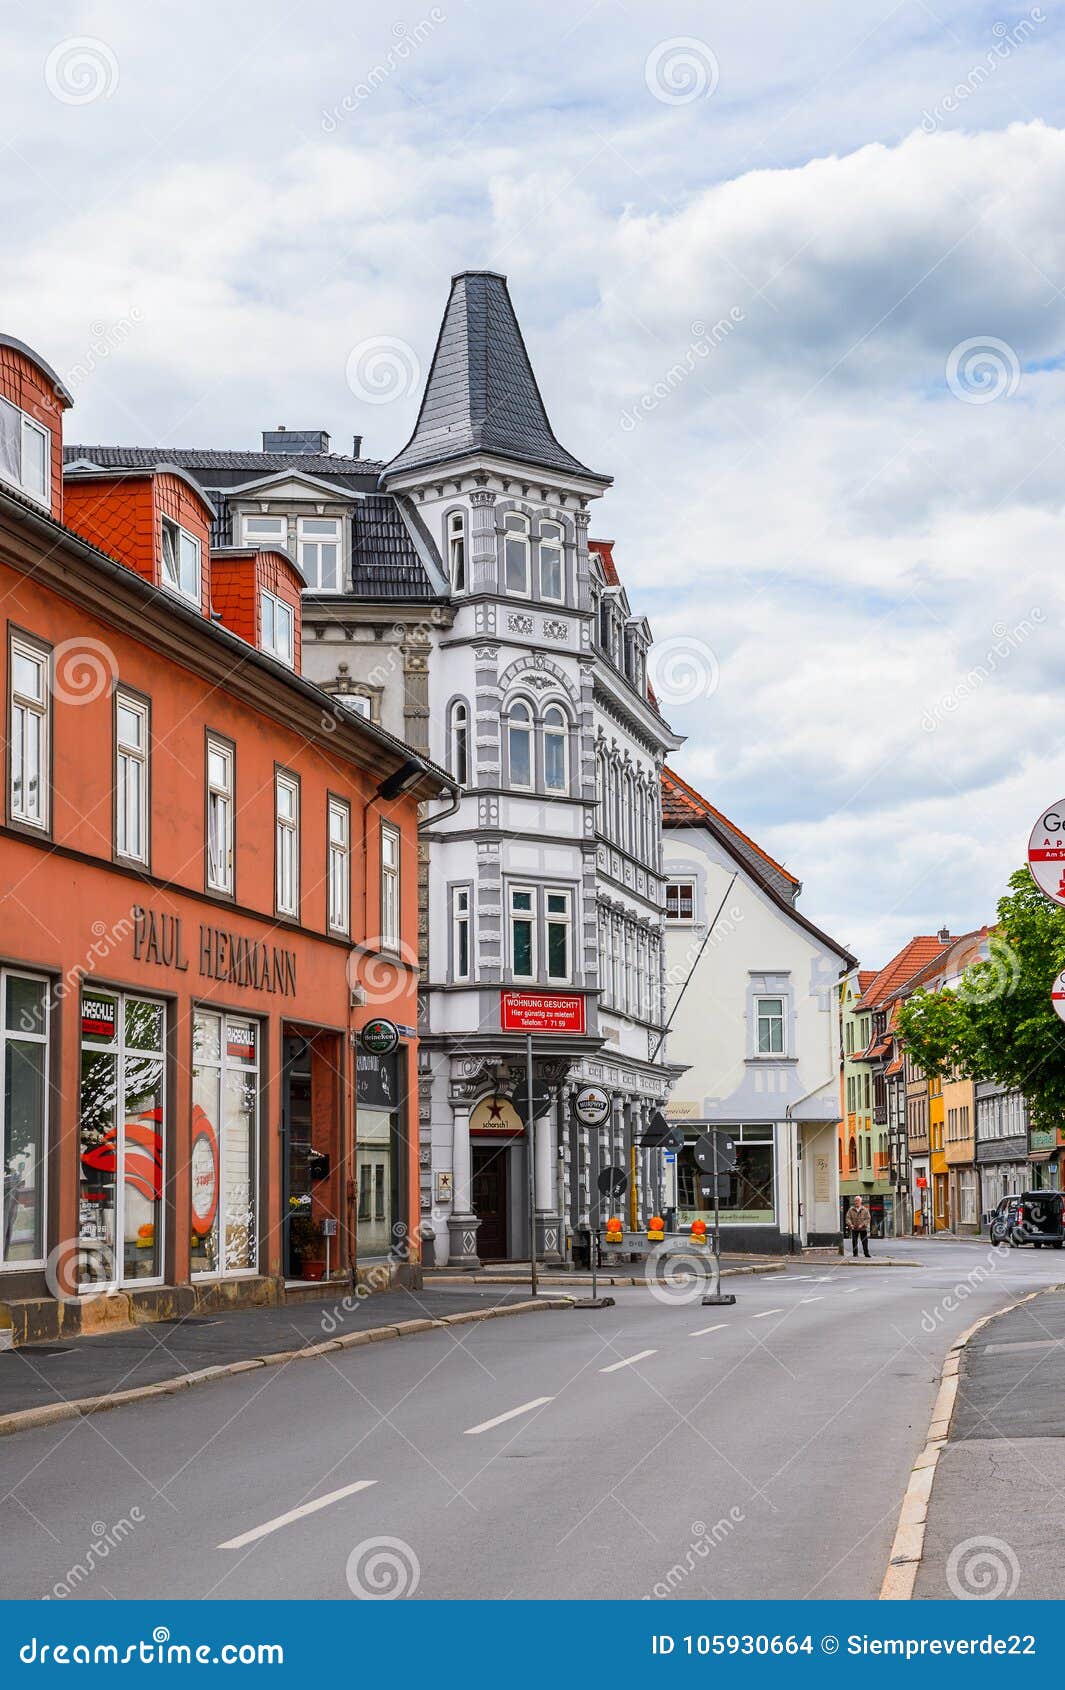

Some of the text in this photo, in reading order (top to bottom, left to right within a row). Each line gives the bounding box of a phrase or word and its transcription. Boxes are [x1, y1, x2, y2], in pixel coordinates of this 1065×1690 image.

[1043, 813, 1065, 832] G
[133, 904, 297, 997] PAUL HEMMANN
[507, 999, 579, 1009] WOHNUNG GESUCHT?
[524, 1010, 546, 1018] günstig
[520, 1018, 543, 1026] Telefon:
